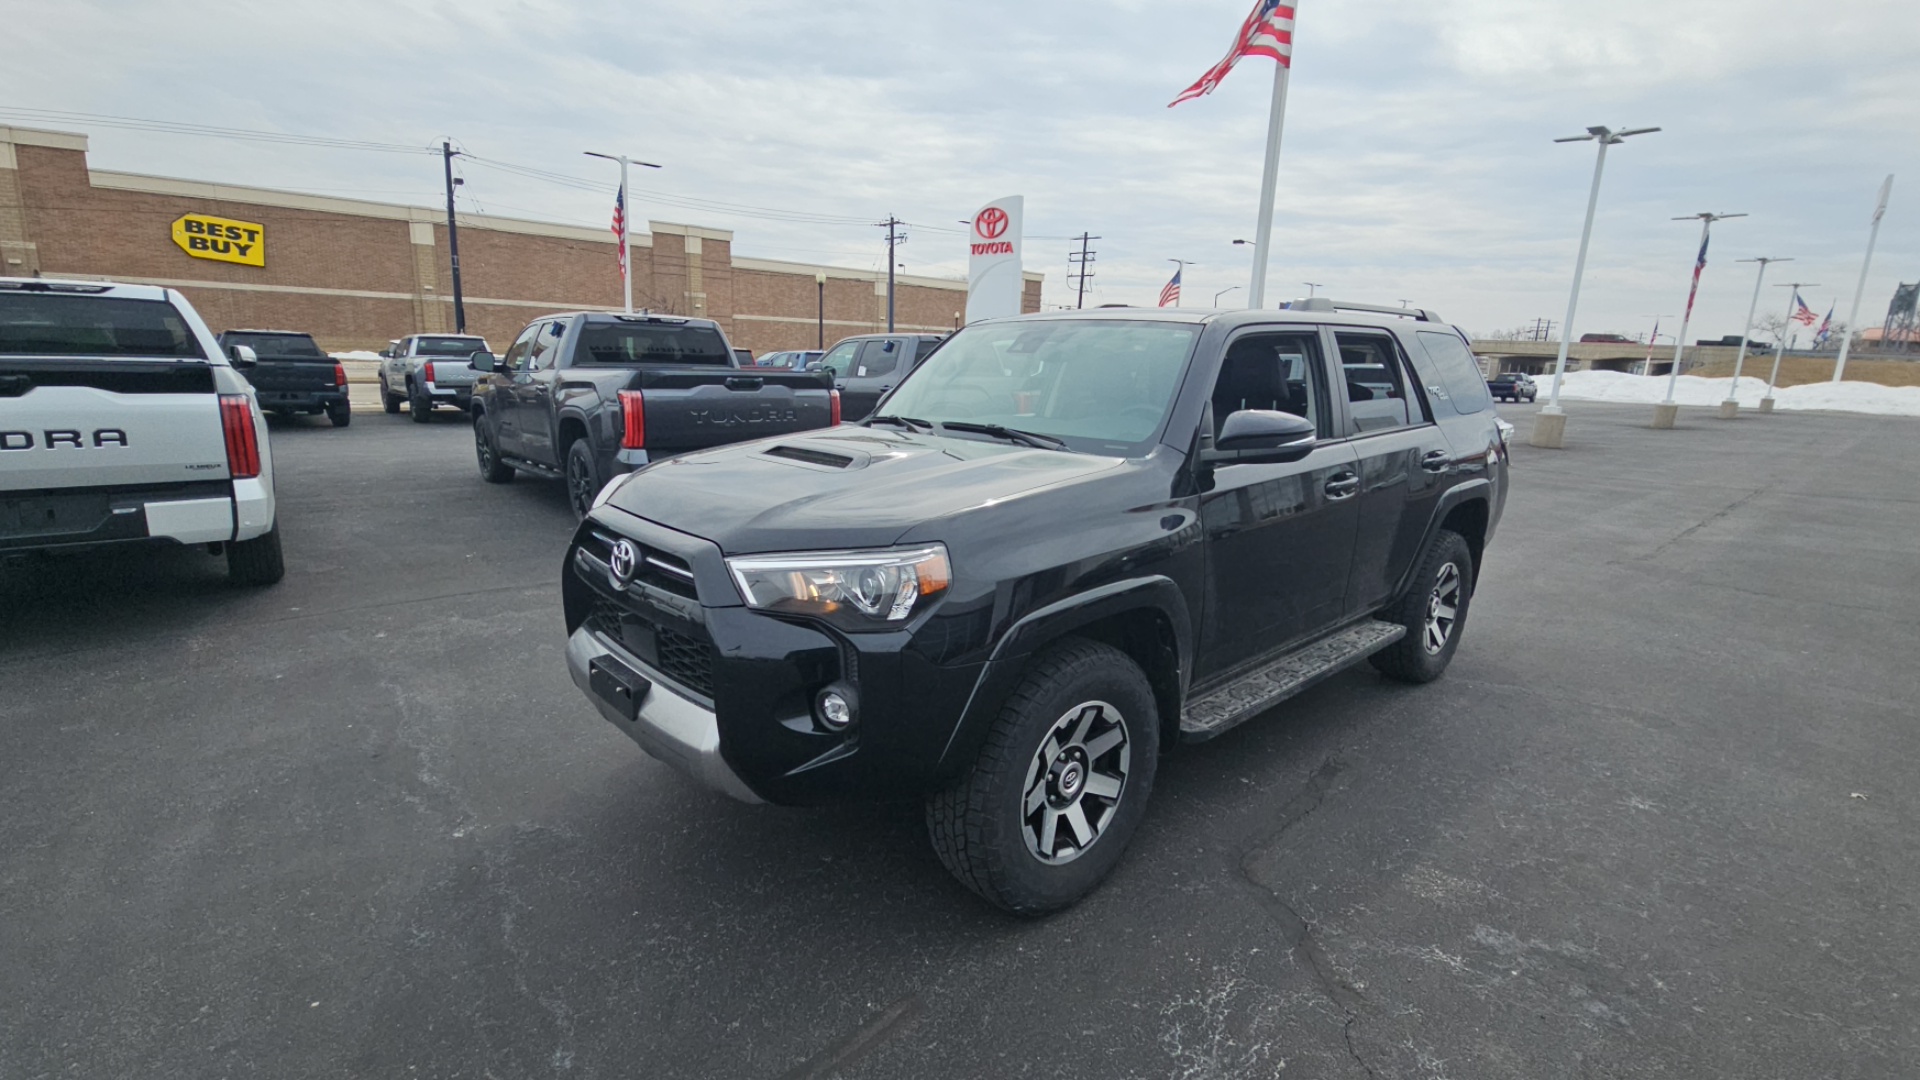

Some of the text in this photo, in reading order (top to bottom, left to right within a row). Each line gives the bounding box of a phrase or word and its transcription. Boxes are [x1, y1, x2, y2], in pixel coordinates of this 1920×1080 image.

[184, 219, 260, 242] BEST
[189, 236, 254, 257] BUY
[970, 241, 1014, 255] TOYOTA
[690, 409, 798, 425] TUNDRA
